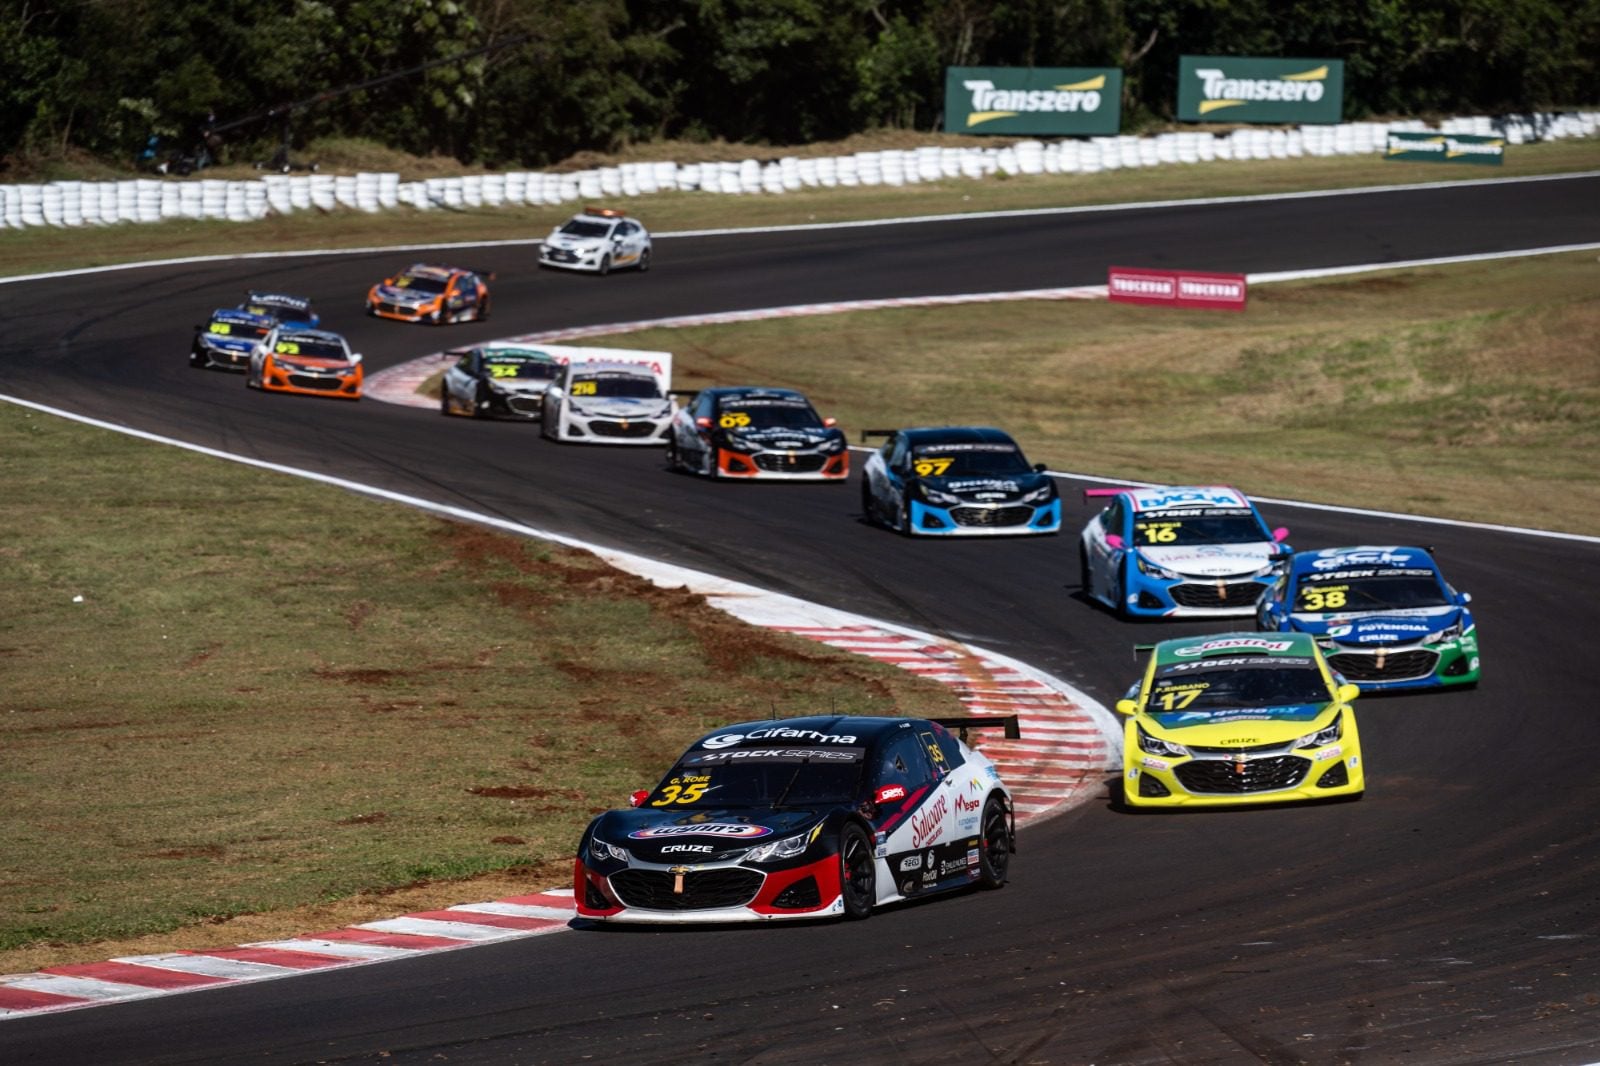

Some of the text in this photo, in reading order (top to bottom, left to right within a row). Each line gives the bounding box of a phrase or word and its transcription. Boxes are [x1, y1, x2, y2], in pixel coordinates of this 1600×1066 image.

[1195, 69, 1324, 102] Transzero
[963, 79, 1101, 112] Transzero
[719, 415, 751, 428] 09
[916, 462, 950, 477] 97
[1144, 528, 1177, 543] 16
[1304, 591, 1347, 611] 38
[1203, 638, 1284, 650] Castrol
[1173, 658, 1247, 671] STOCK
[1160, 689, 1203, 711] 17
[745, 727, 857, 744] Cifarma
[702, 750, 857, 761] STOCK SERIES
[651, 783, 709, 807] 35
[661, 845, 714, 853] CRUZE
